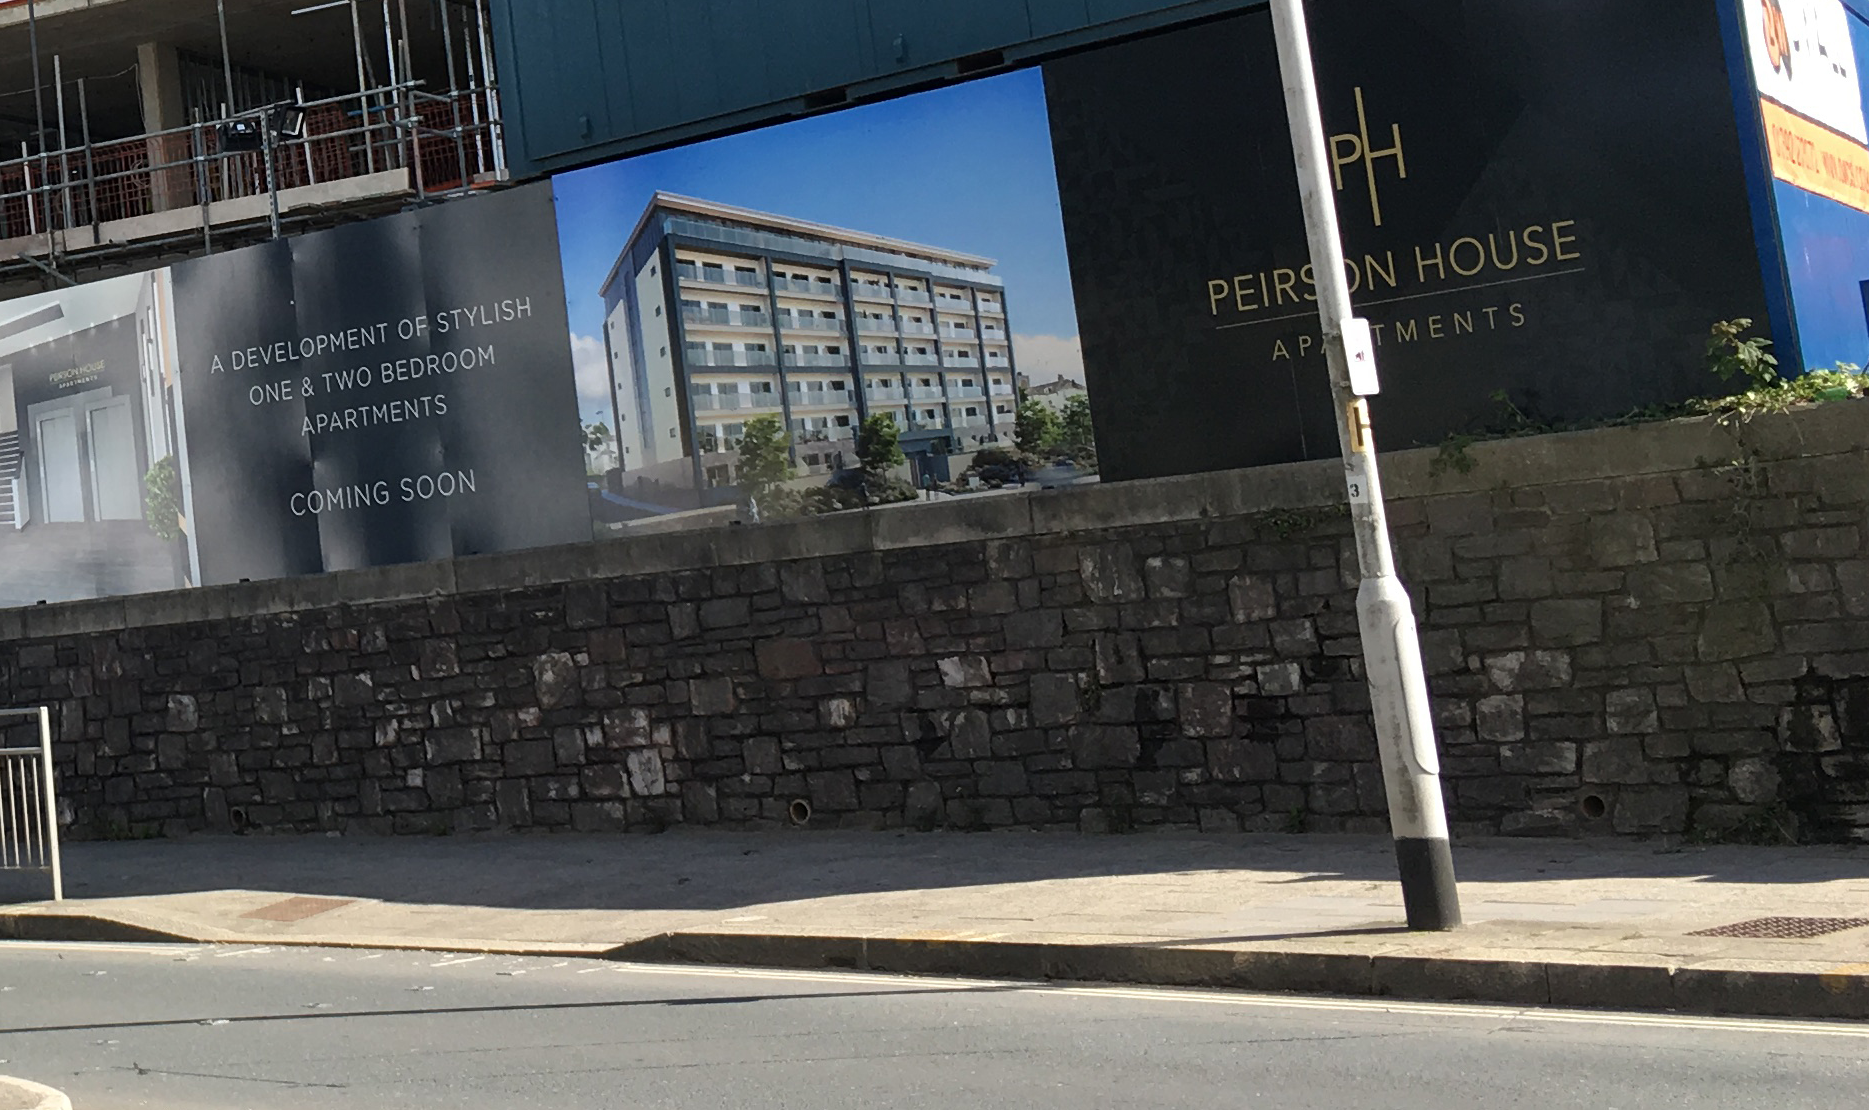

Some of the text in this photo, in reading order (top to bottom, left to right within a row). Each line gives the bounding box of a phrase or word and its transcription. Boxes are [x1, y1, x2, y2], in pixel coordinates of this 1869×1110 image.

[1330, 86, 1406, 227] PH
[1415, 220, 1581, 284] HOUSE
[210, 297, 532, 374] A DEVELOPMENT OF STYLISH
[1272, 303, 1526, 361] APTMENTS
[249, 344, 495, 406] ONE & TWO BEDROOM
[301, 394, 447, 436] APARTMENTS
[290, 469, 476, 517] COMING SOON
[1350, 484, 1359, 498] 3
